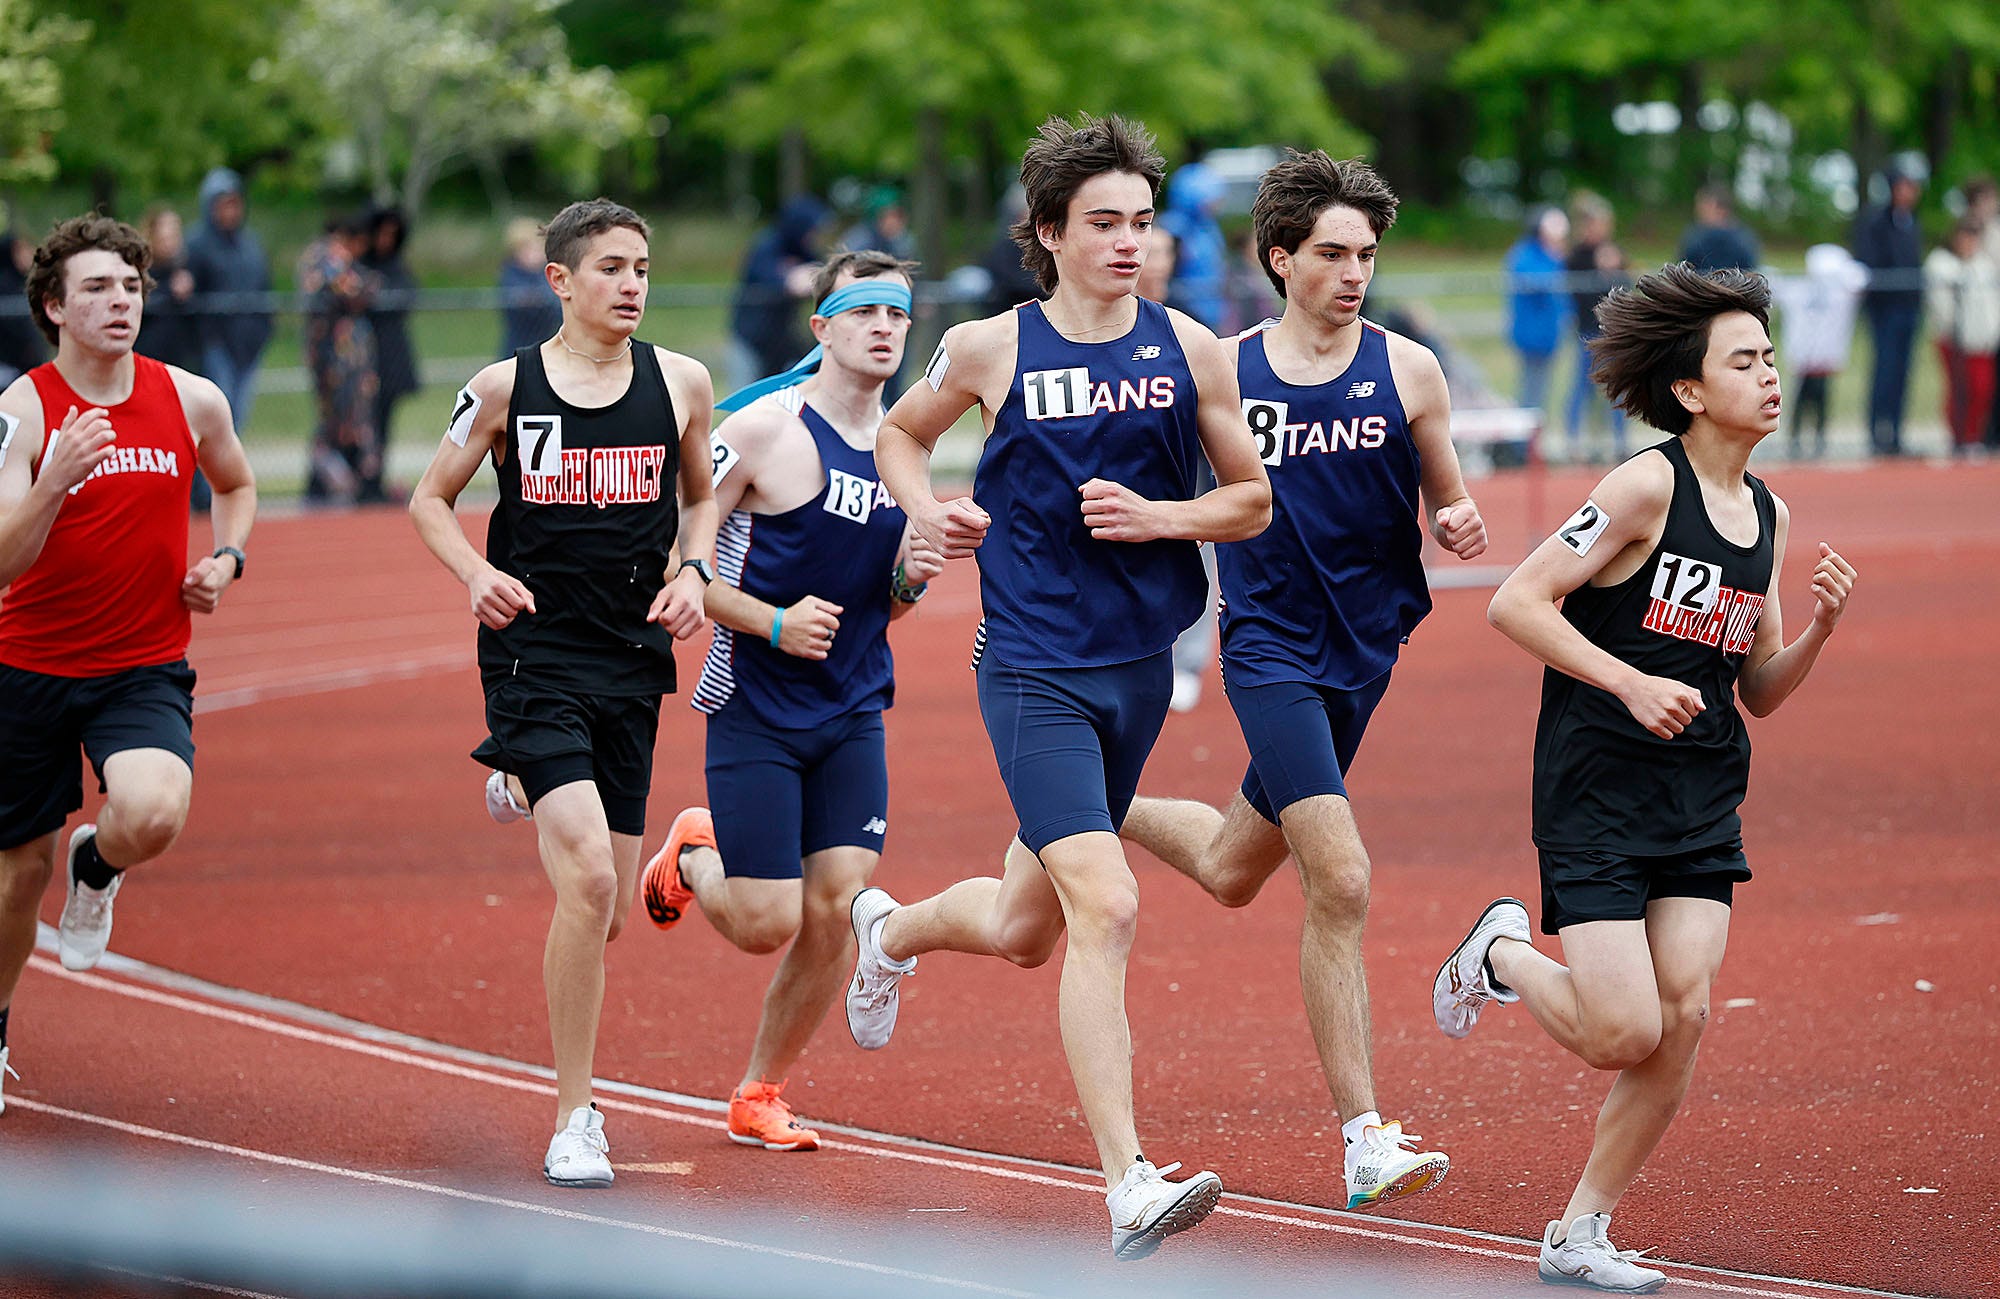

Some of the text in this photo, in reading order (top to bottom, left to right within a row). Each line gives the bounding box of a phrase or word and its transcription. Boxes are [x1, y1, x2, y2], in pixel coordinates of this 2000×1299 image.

[450, 391, 475, 431] 7
[1028, 371, 1074, 416] 11
[1088, 376, 1176, 416] ANS
[522, 421, 554, 471] 7
[1247, 405, 1277, 460] 8
[590, 445, 666, 509] QUINCY
[835, 476, 864, 518] 13
[1560, 506, 1598, 549] 2
[1663, 558, 1712, 610] 12
